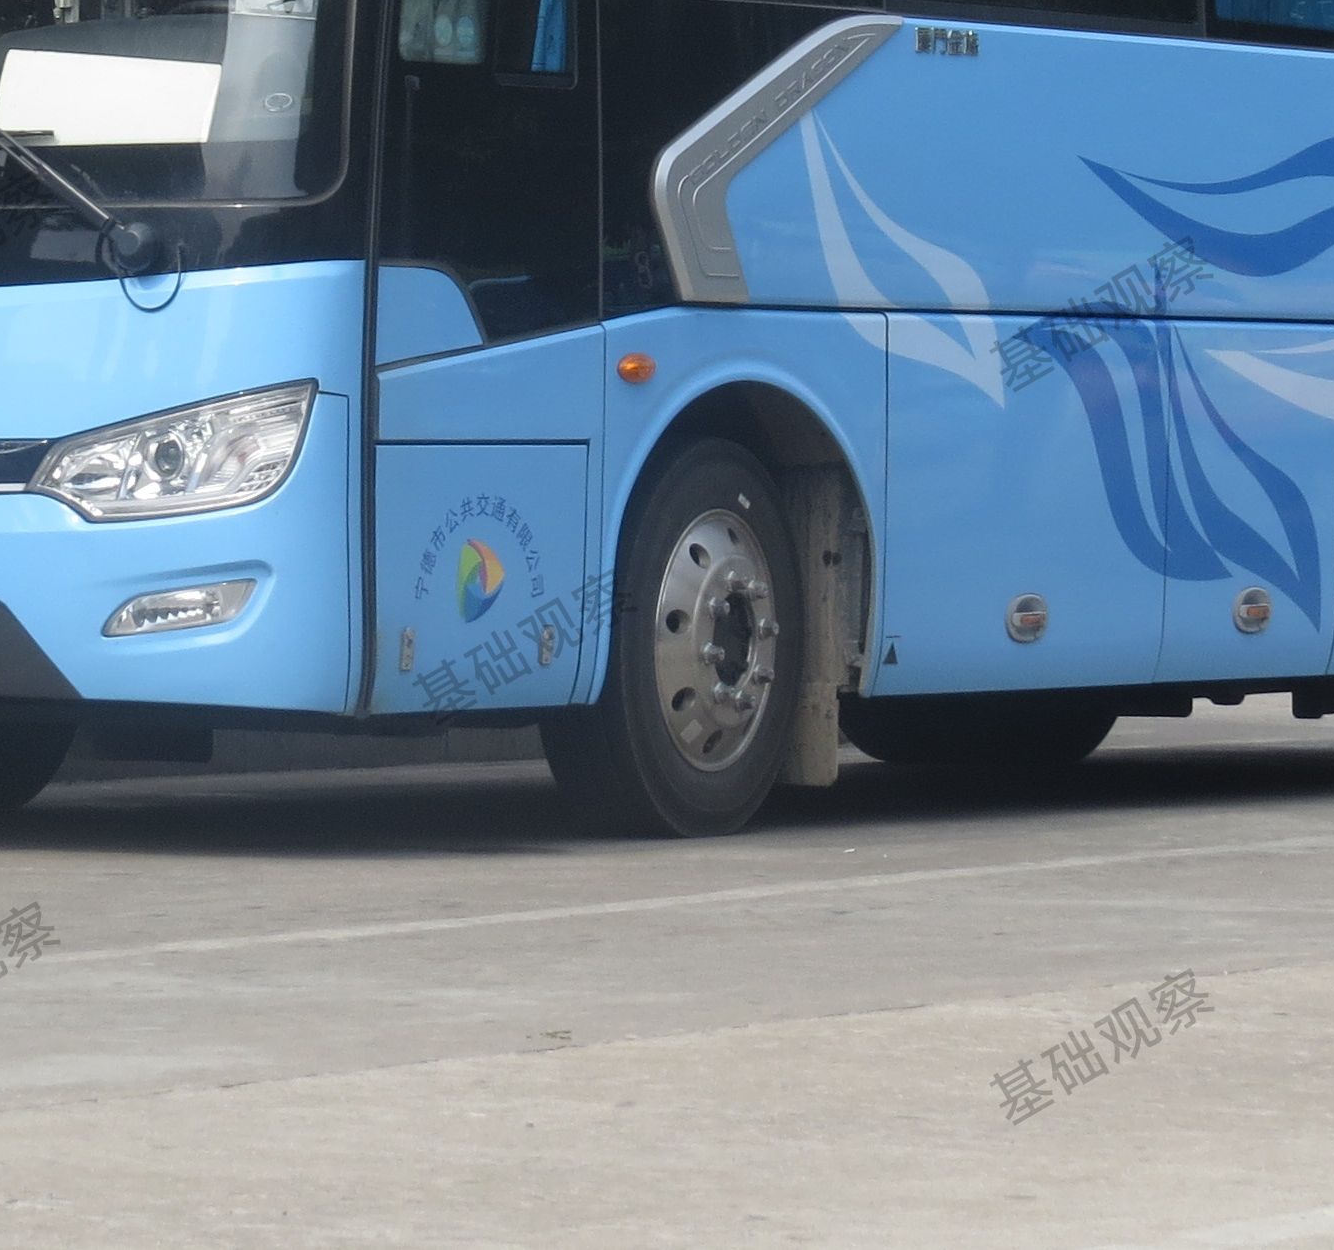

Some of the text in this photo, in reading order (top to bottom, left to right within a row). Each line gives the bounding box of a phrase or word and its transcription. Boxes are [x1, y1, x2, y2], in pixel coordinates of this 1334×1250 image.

[414, 493, 545, 600] 宁德市公共交通有限公司
